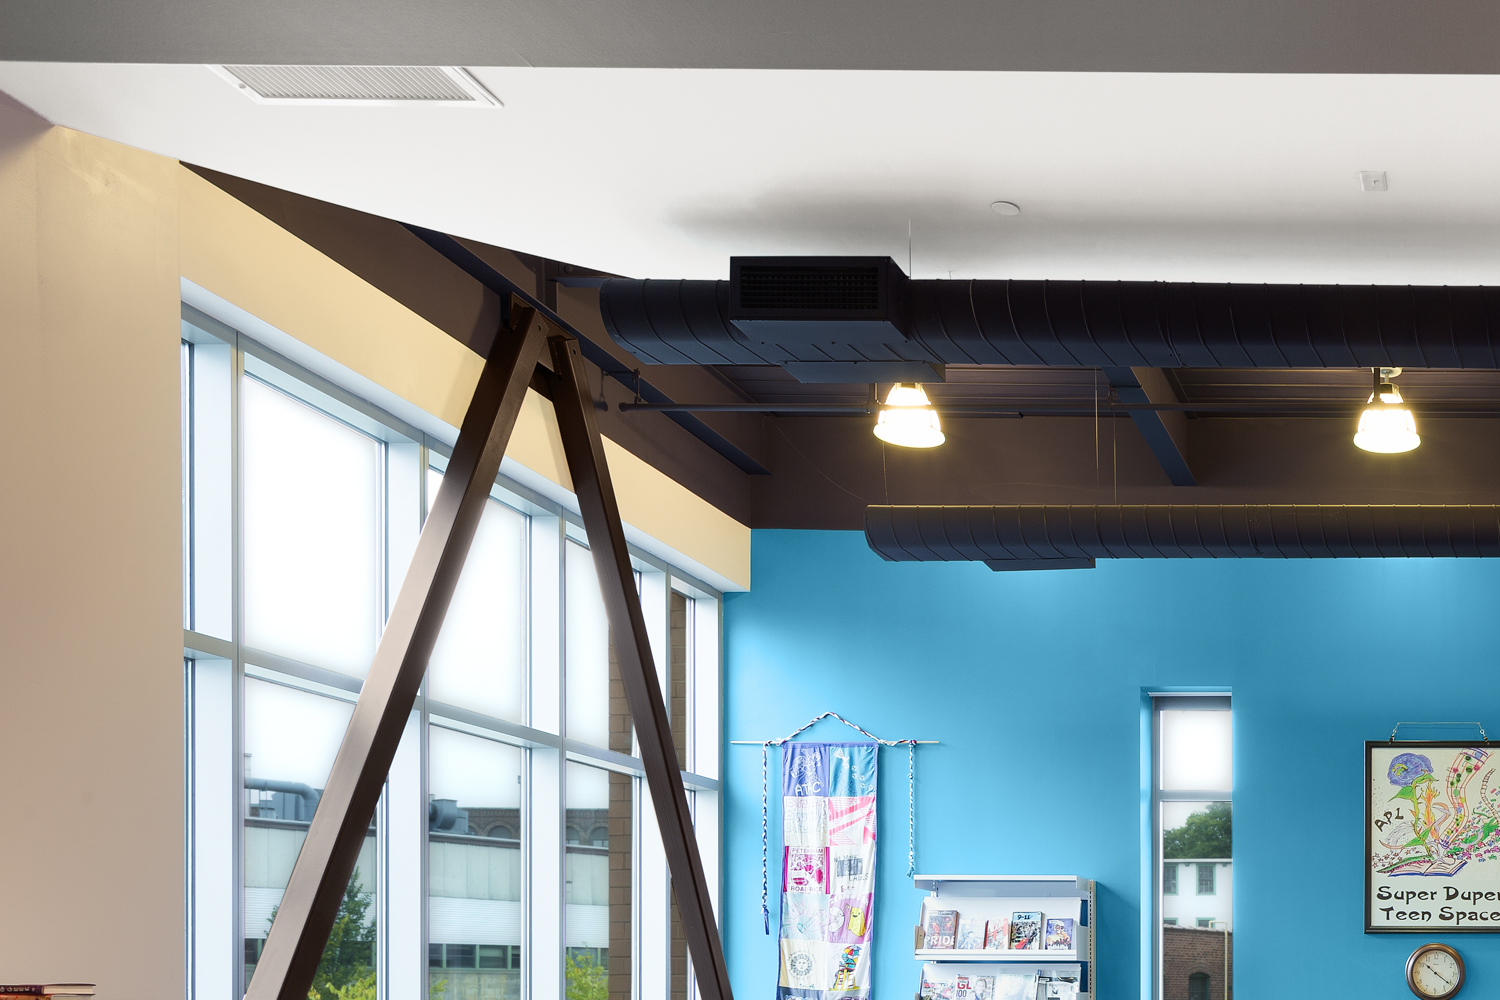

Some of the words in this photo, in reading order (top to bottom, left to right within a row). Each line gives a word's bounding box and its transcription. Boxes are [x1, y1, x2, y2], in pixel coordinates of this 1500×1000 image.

[795, 782, 821, 796] ATAC
[1374, 807, 1404, 832] APL
[1377, 886, 1437, 904] Super
[1379, 906, 1432, 922] Teen
[1439, 906, 1500, 925] Space
[925, 936, 955, 946] PRIDE
